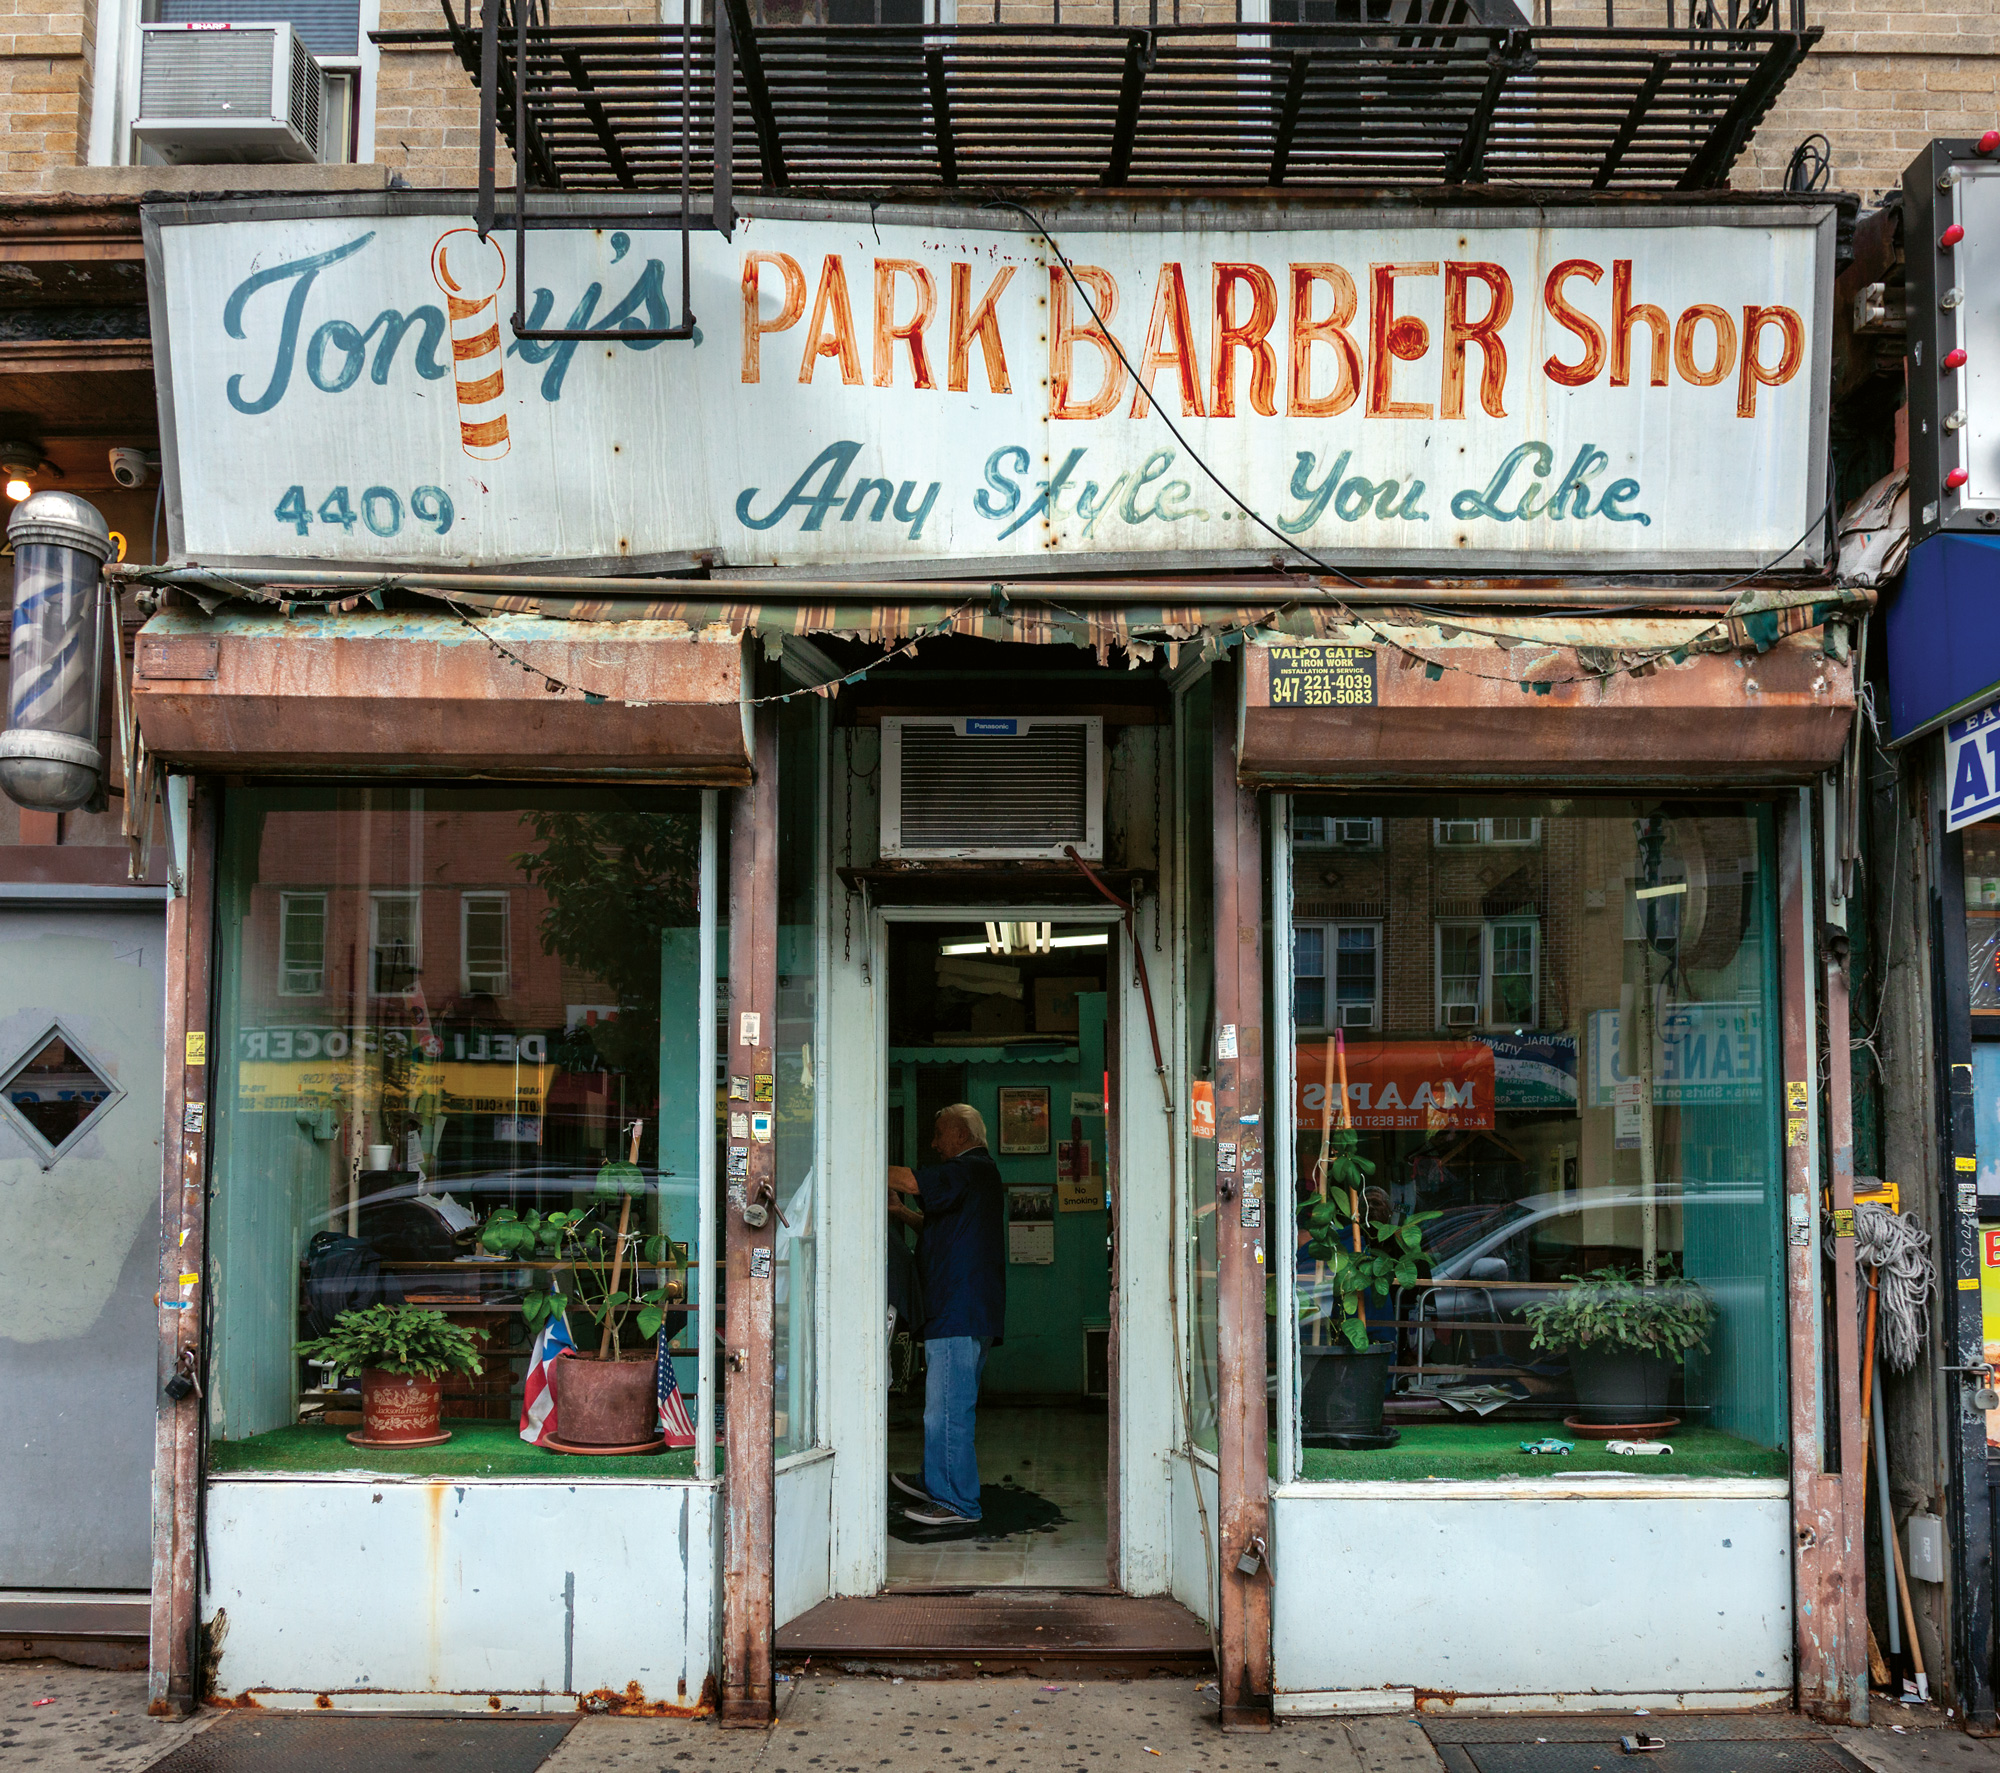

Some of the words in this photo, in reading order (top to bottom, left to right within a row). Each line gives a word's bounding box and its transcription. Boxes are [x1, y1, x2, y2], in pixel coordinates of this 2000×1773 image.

[739, 250, 1017, 394] PARK
[1048, 261, 1514, 420] BARBER
[1542, 259, 1804, 419] Shop
[736, 440, 942, 540] Any
[1277, 449, 1430, 534] You
[1451, 442, 1651, 528] Like
[274, 484, 455, 538] 4409
[1270, 648, 1320, 659] VALPO
[1325, 648, 1372, 658] GATES
[1301, 659, 1324, 667] IRON
[1304, 675, 1372, 690] 221-4039
[1304, 690, 1372, 704] 320-5083
[1064, 1197, 1098, 1205] Smoking
